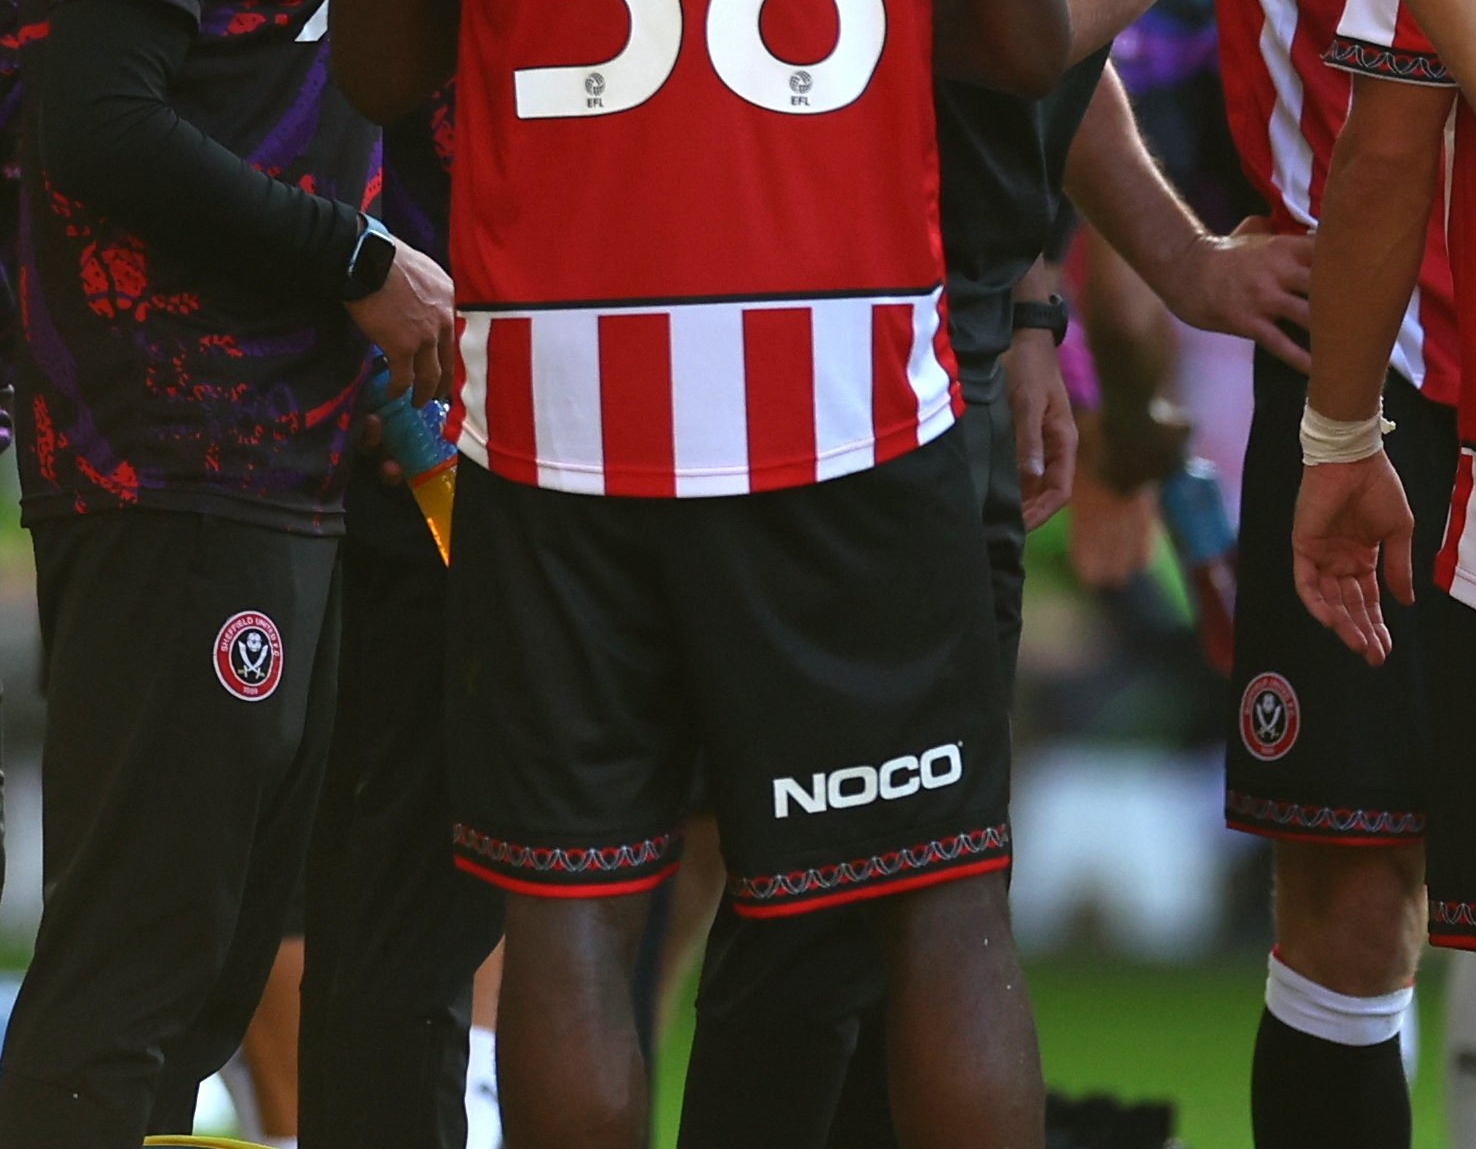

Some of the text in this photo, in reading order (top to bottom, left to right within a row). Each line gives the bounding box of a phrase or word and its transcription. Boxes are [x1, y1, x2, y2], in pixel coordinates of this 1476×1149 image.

[586, 96, 604, 109] EFL
[791, 95, 810, 107] EFL
[773, 742, 963, 819] NOCO
